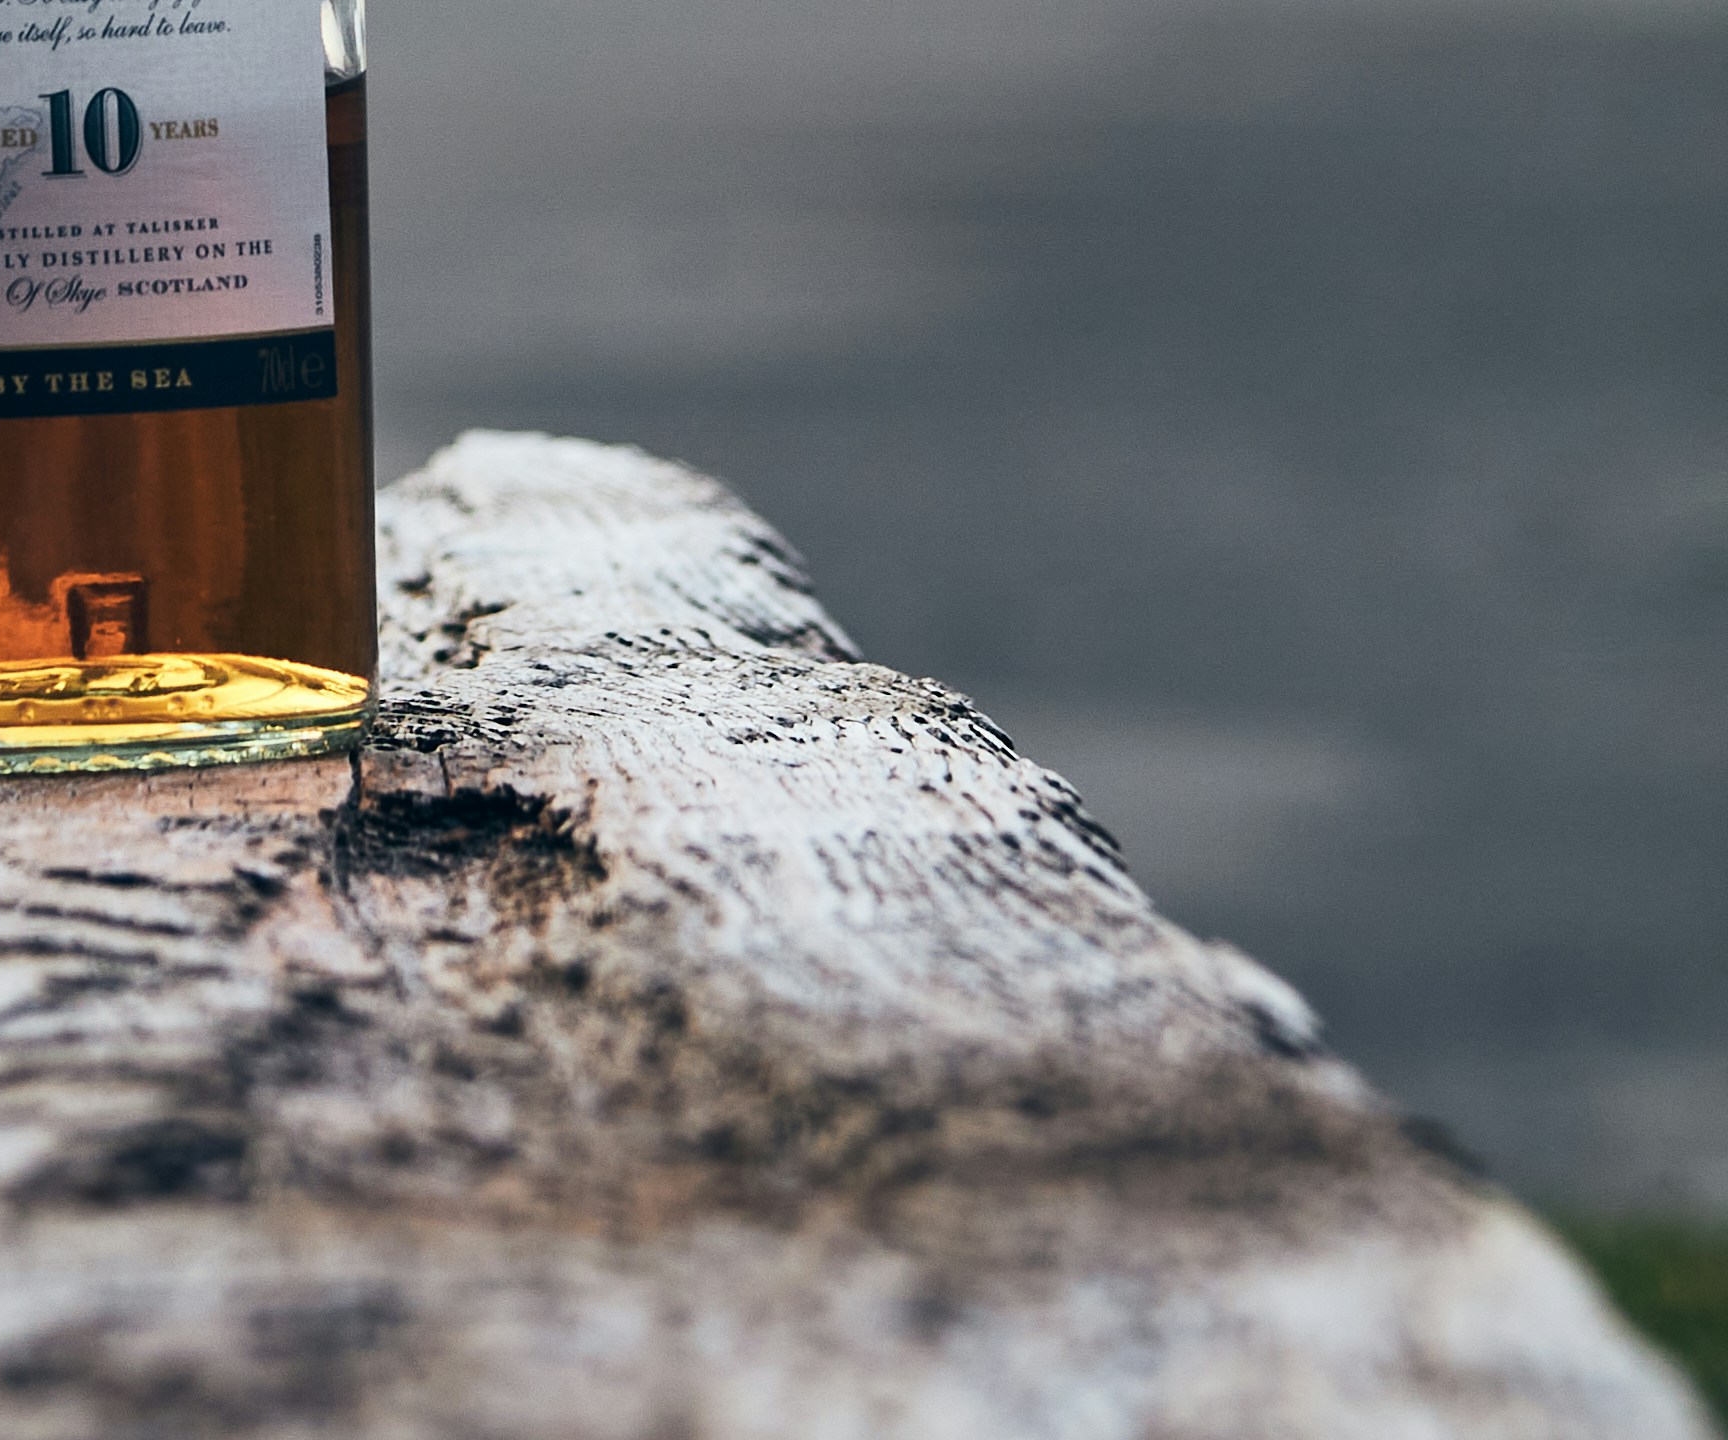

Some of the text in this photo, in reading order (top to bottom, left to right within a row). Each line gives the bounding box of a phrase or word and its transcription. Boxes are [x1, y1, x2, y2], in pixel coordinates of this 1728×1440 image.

[18, 16, 73, 51] itself,
[77, 26, 97, 41] so
[101, 15, 155, 40] hard
[156, 15, 174, 34] to
[179, 11, 232, 34] leave.
[38, 87, 142, 180] 10
[149, 118, 219, 142] YEARS
[92, 223, 117, 238] AT
[127, 217, 219, 234] TALISKER
[42, 244, 186, 269] DISTILLERY
[195, 242, 226, 260] ON
[236, 239, 273, 257] THE
[6, 276, 40, 313] Of
[44, 274, 108, 314] Skye
[117, 274, 249, 297] SCOTLAND
[46, 371, 113, 394] THE
[131, 368, 193, 391] SEA
